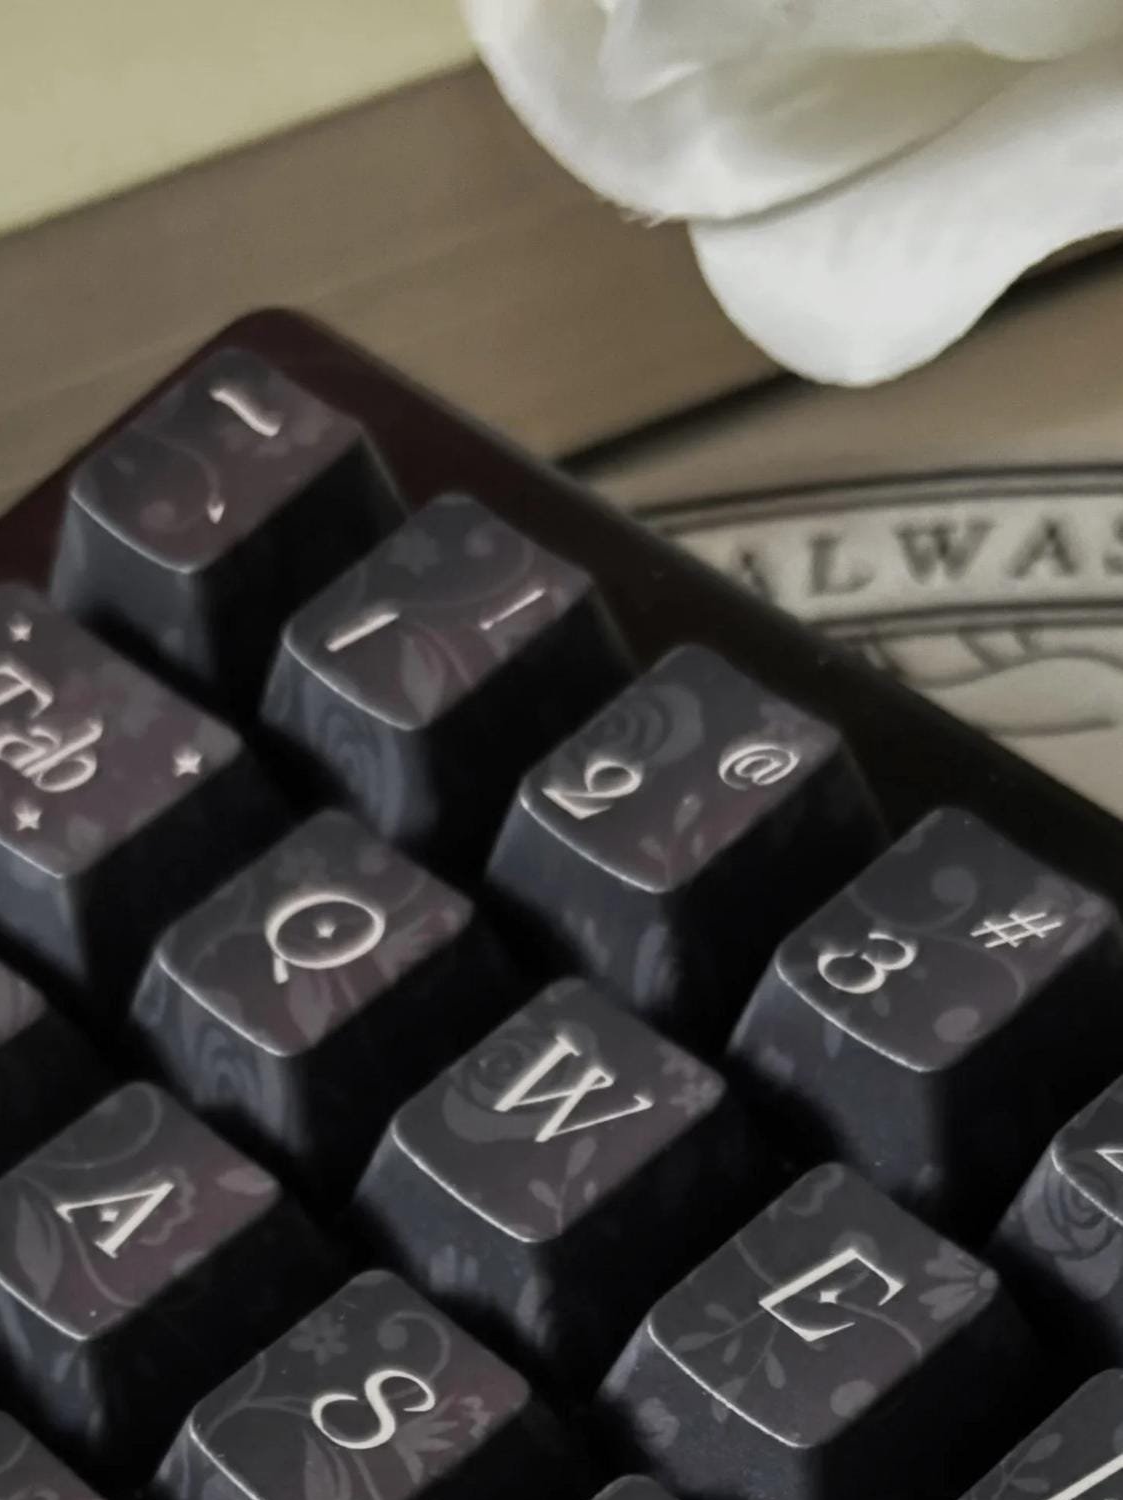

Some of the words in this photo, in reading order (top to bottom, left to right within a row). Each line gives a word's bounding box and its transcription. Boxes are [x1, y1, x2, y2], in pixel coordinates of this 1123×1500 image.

[716, 742, 800, 790] @
[264, 892, 386, 984] Q
[816, 930, 919, 994] 3
[969, 910, 1064, 949] #
[492, 1032, 655, 1143] W
[55, 1180, 175, 1259] A
[758, 1247, 905, 1342] E
[311, 1368, 436, 1450] S
